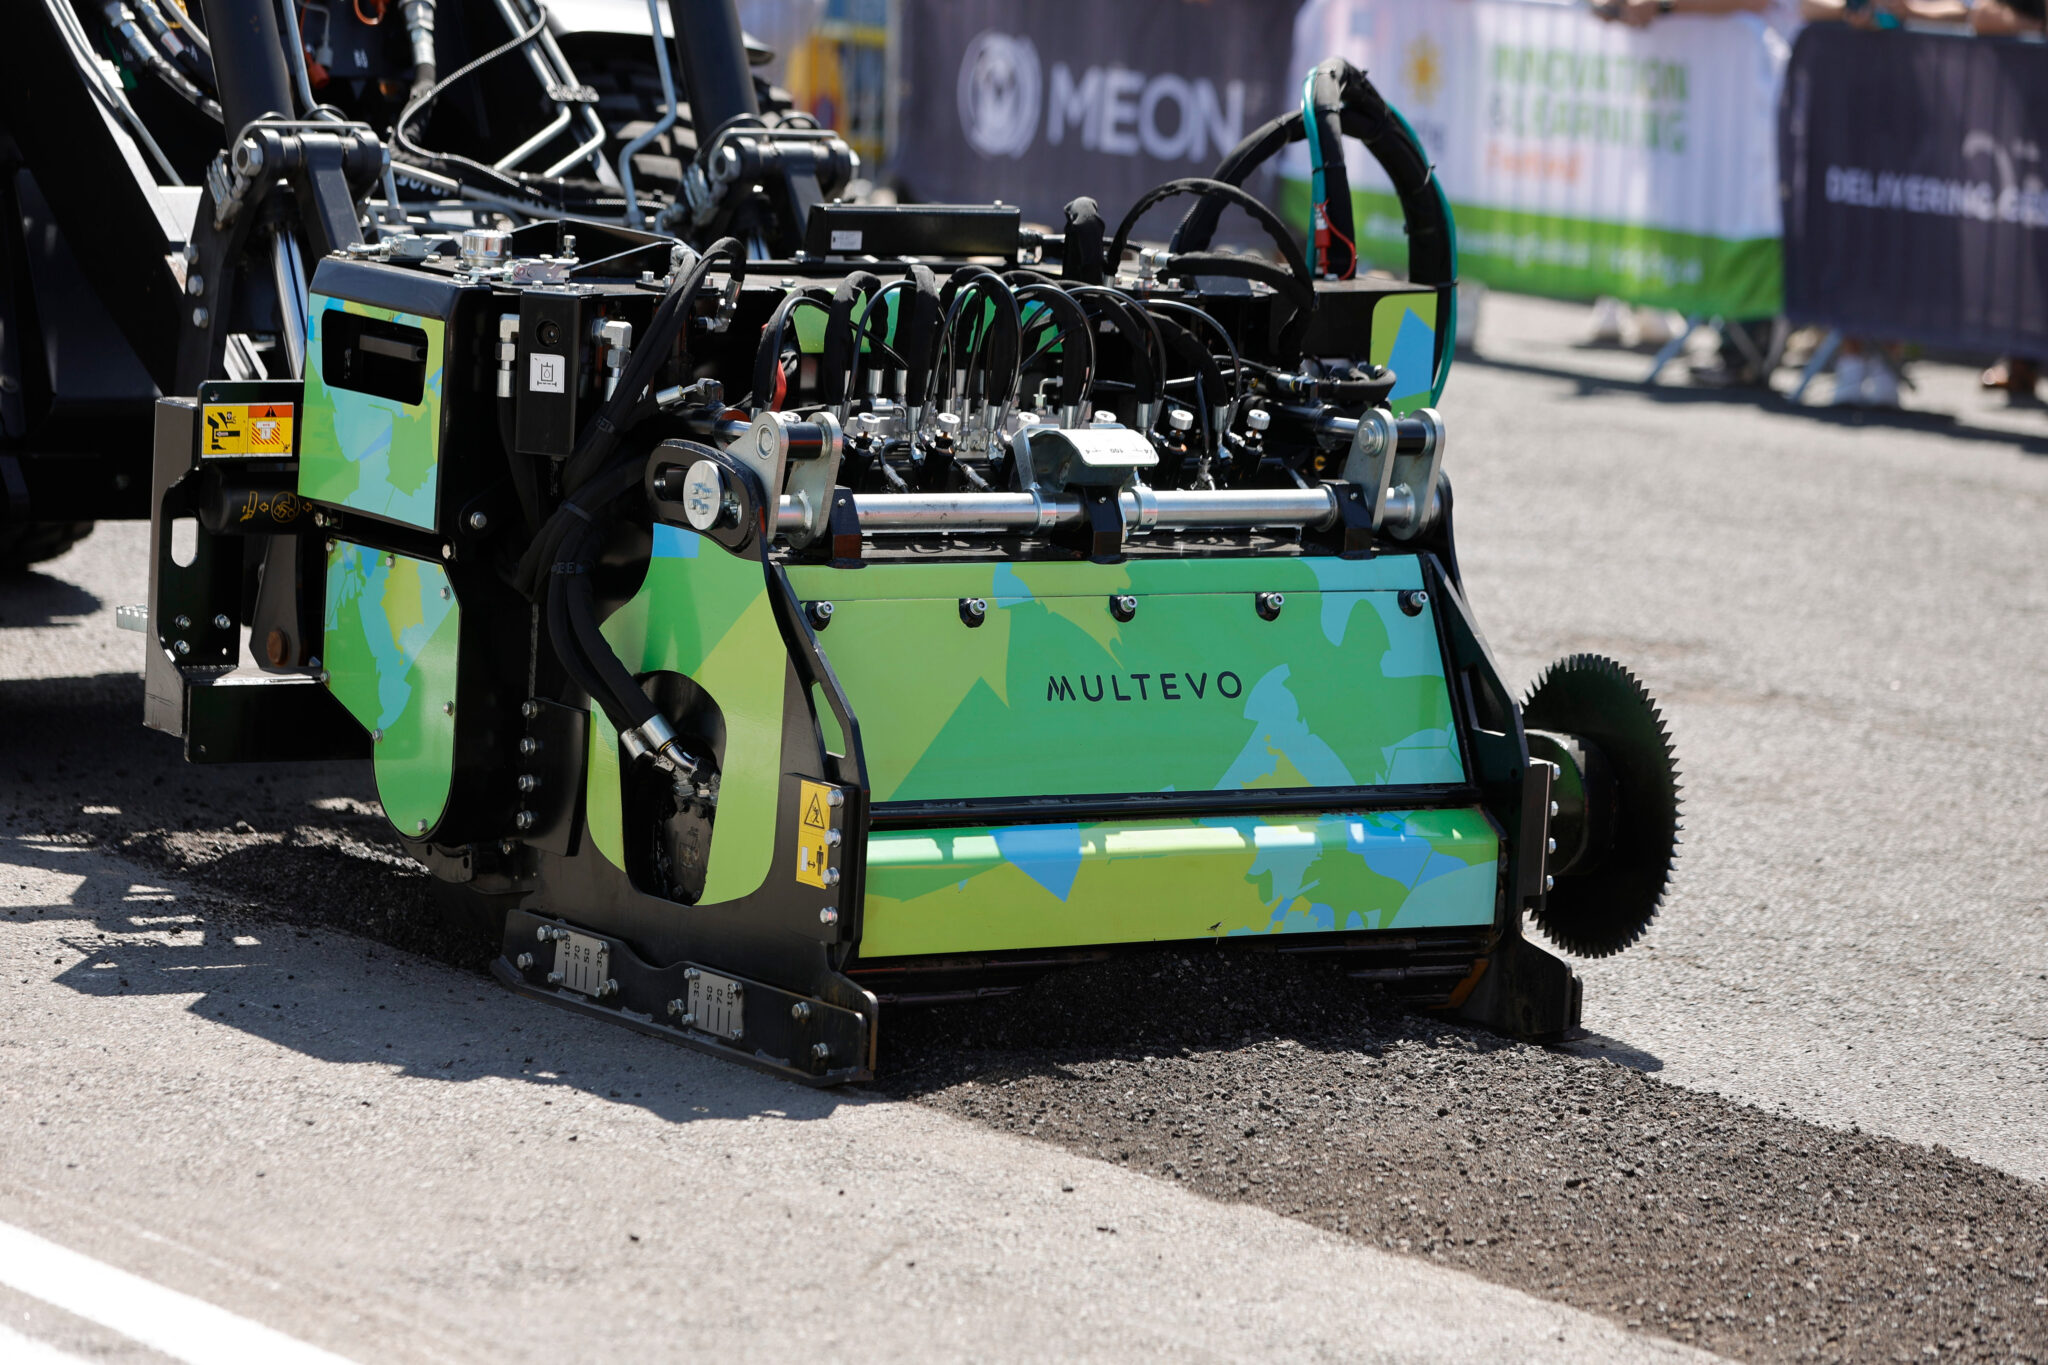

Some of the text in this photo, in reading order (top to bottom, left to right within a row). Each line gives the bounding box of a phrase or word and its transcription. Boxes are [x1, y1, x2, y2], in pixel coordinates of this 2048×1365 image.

[1046, 62, 1246, 163] MEON
[1824, 164, 1994, 222] DELIVERING
[1047, 671, 1243, 702] MULTEVO
